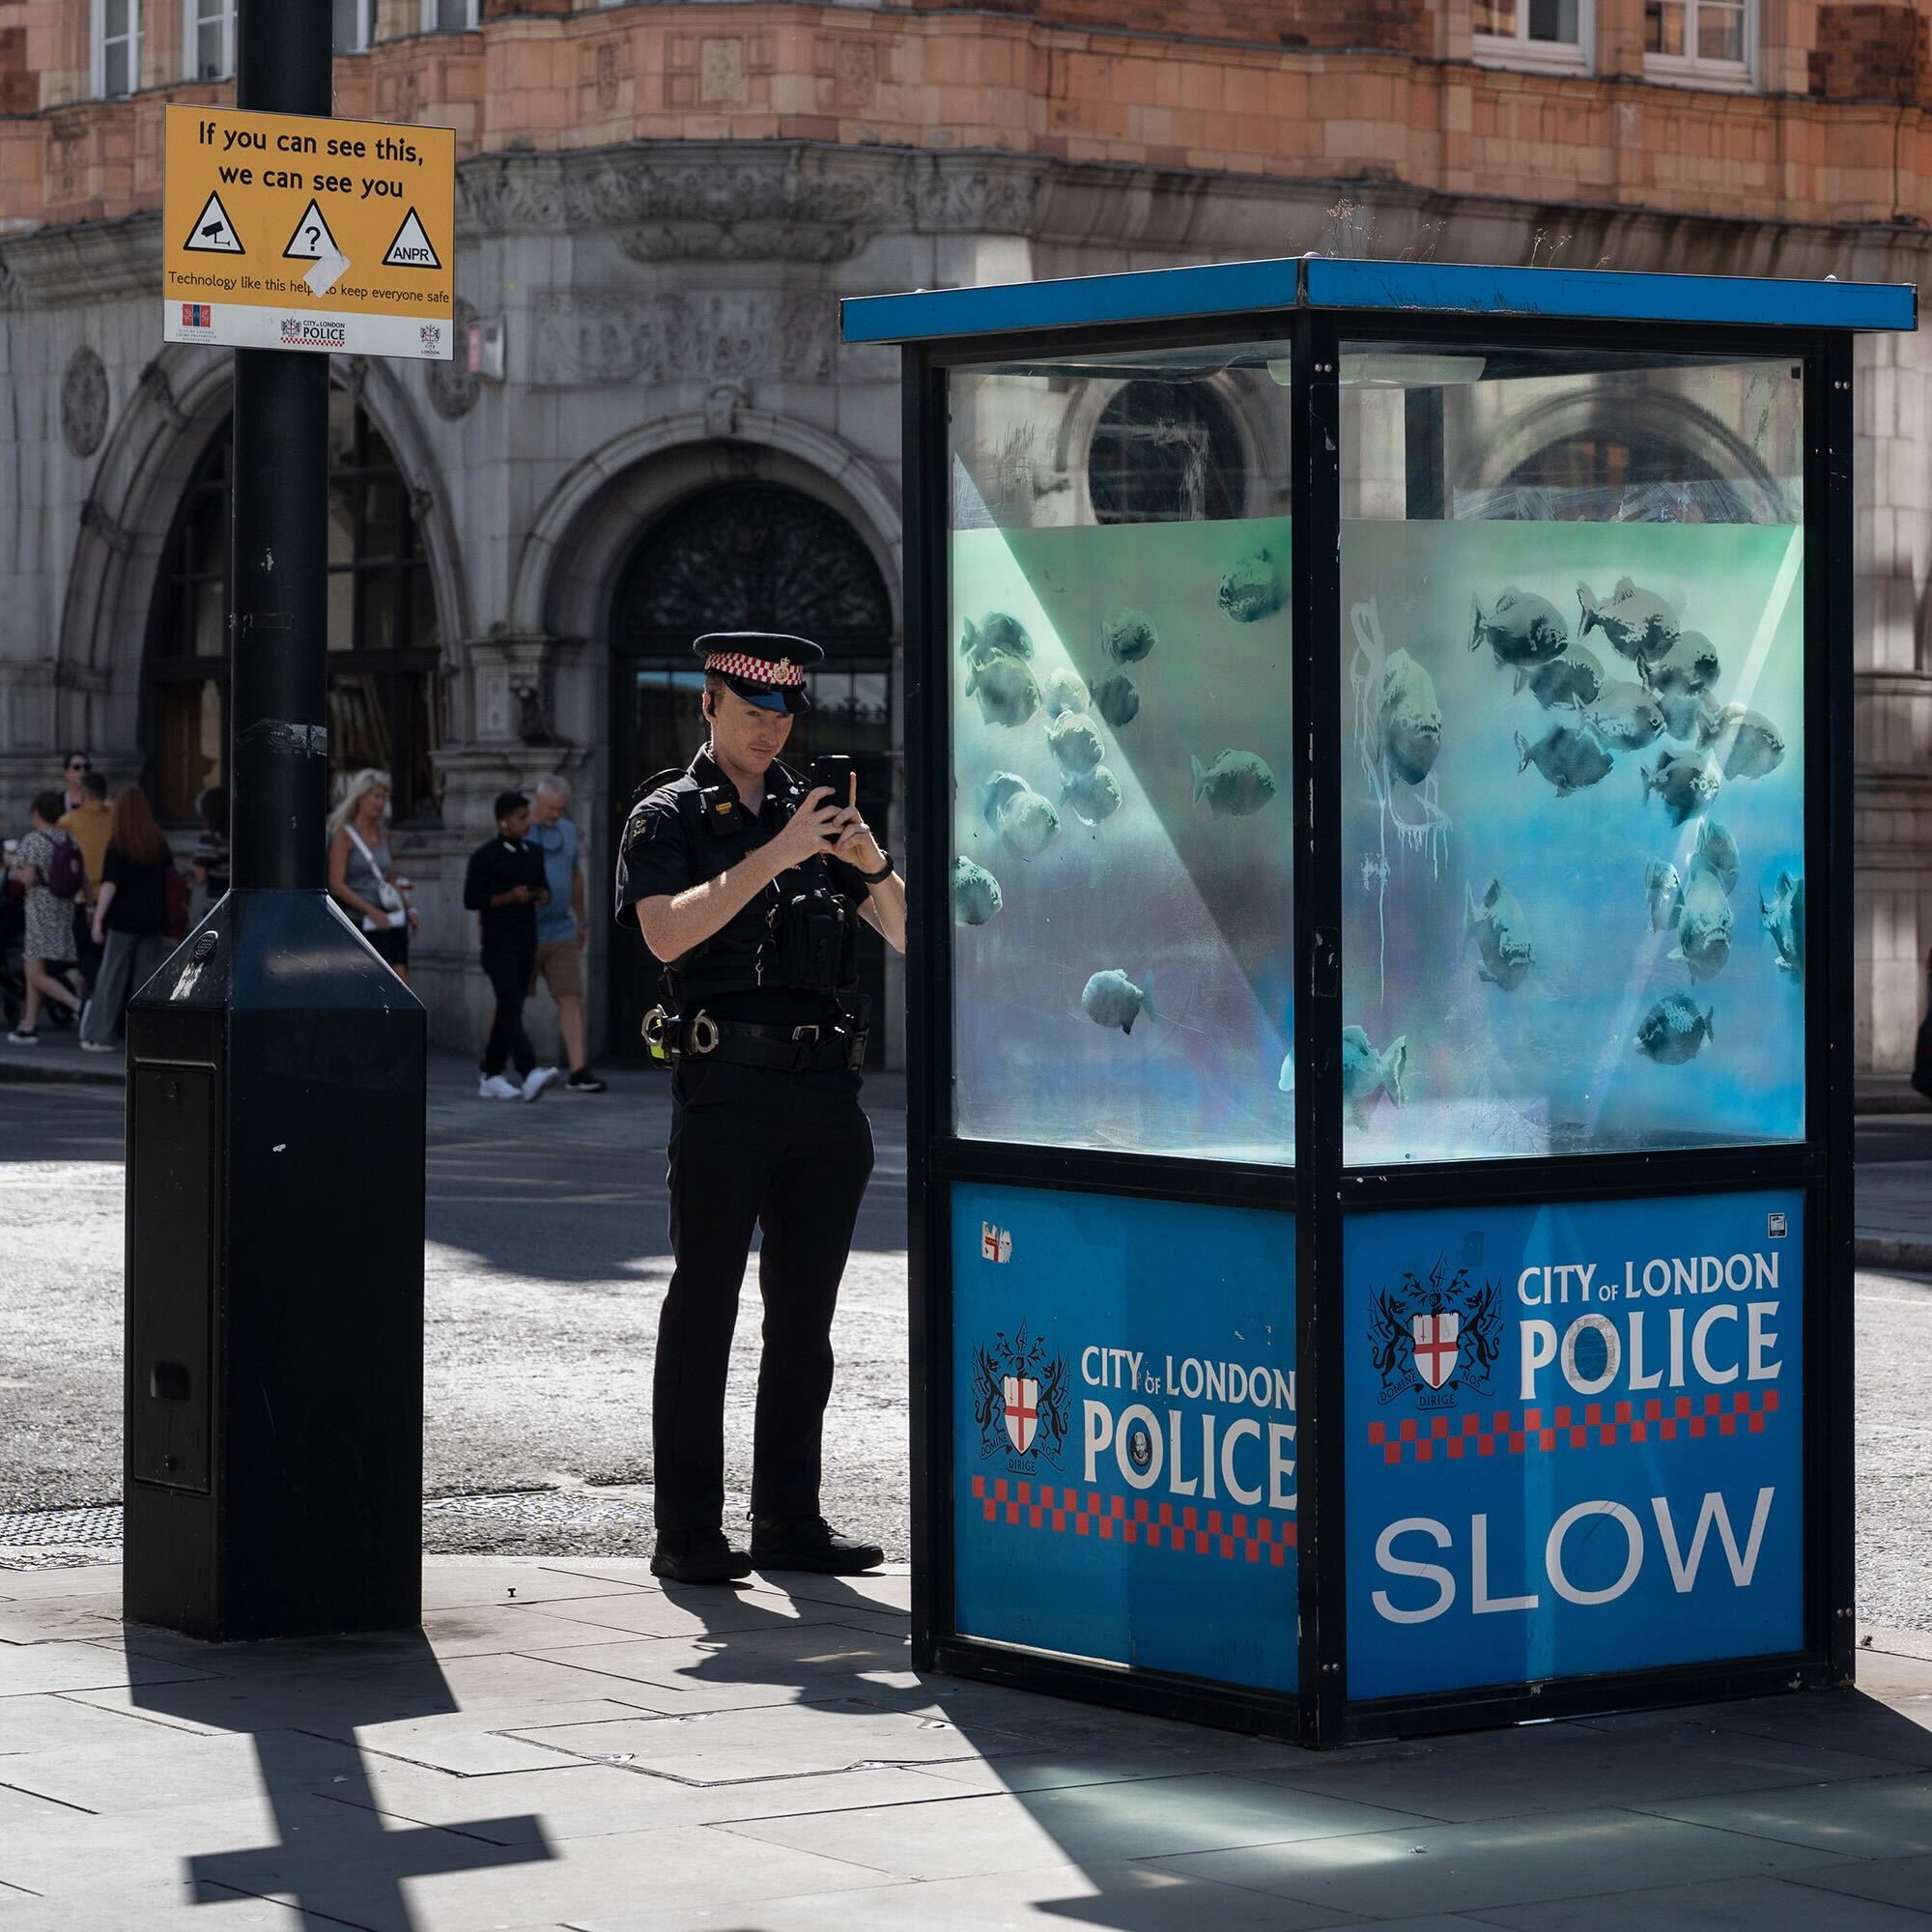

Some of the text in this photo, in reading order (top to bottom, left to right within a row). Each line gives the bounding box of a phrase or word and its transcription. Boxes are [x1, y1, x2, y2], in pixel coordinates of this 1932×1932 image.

[199, 121, 423, 166] If you can see this,
[218, 165, 403, 199] we can see you
[393, 246, 429, 261] ANPR
[168, 271, 237, 290] Technology
[242, 276, 261, 290] like
[265, 277, 286, 292] this
[341, 285, 368, 299] keep
[372, 289, 423, 303] everyone
[427, 291, 449, 304] safe
[303, 327, 345, 340] POLICE
[1518, 1252, 1779, 1306] CITY OF LONDON
[1520, 1301, 1783, 1401] POLICE
[1081, 1346, 1296, 1411] CITY OF LONDON
[1379, 1371, 1483, 1407] DOMINE DIRIGE NOS
[980, 1433, 1009, 1457] DOMINE
[1009, 1459, 1036, 1472] DIRIGE
[1083, 1399, 1298, 1511] POLICE
[1371, 1487, 1776, 1625] SLOW
